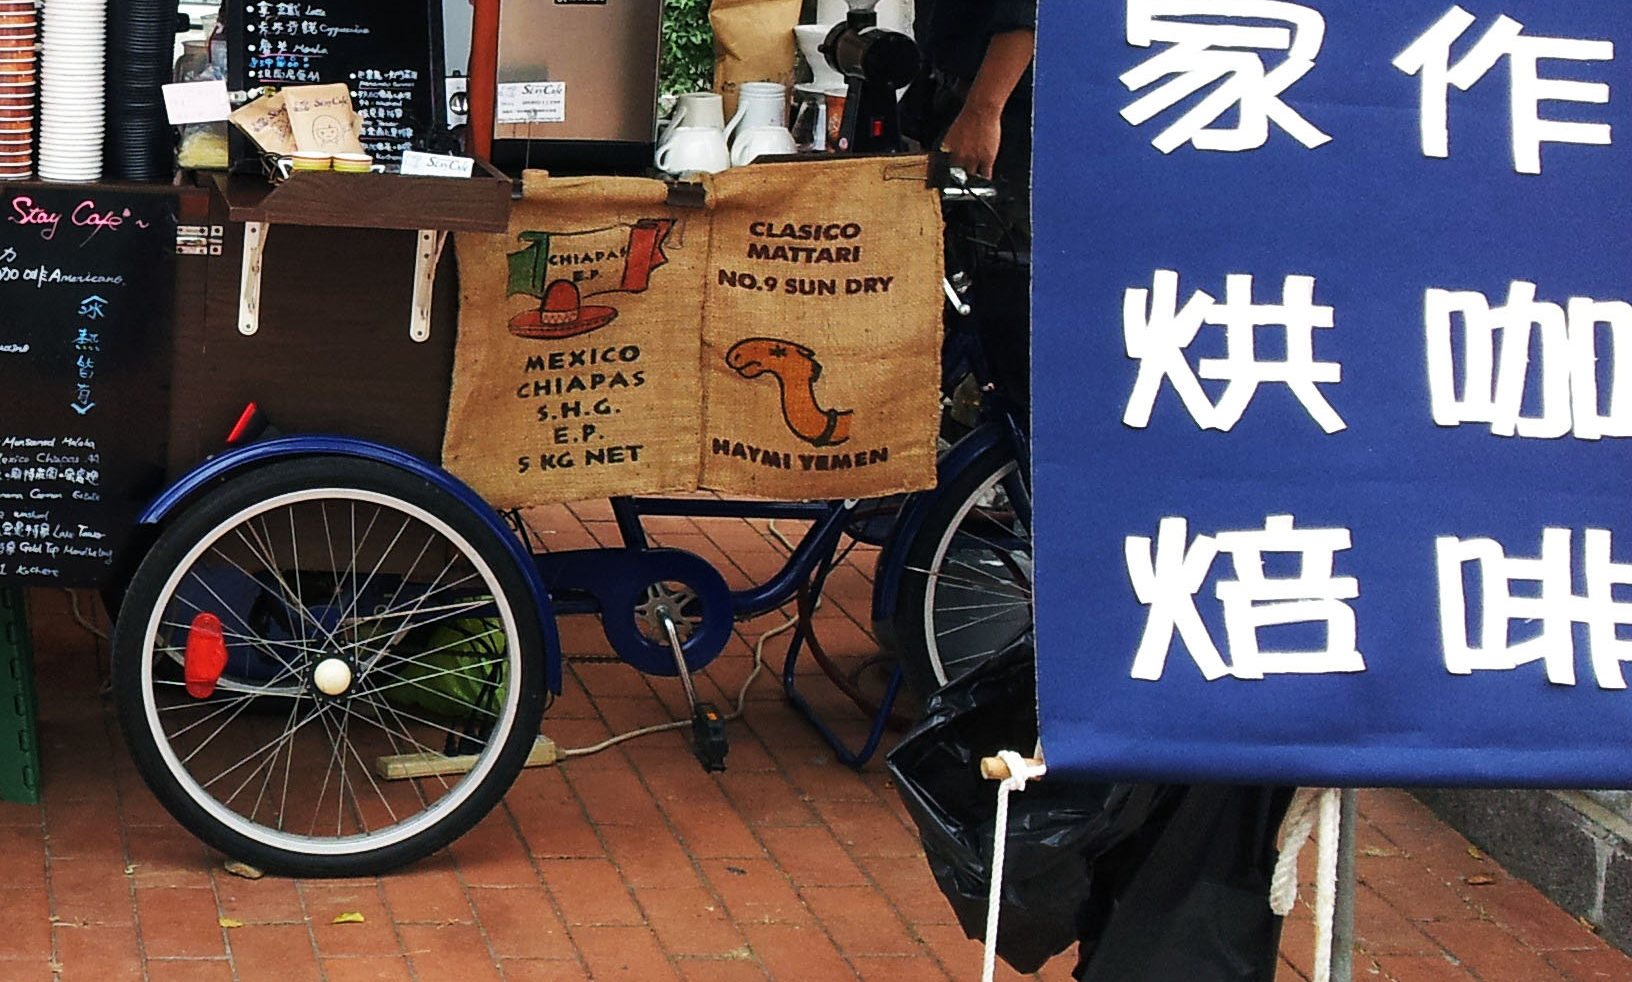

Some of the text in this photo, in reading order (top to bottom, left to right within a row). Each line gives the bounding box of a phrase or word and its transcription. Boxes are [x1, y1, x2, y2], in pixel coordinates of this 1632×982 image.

[8, 196, 63, 241] Stay
[749, 221, 862, 241] CLASICO
[747, 241, 861, 263] MATTARI
[718, 269, 894, 296] NO.9 SUN DRY
[524, 344, 640, 374] MEXICO
[516, 370, 646, 399] CHIAPAS
[537, 396, 622, 422] S.H.G.
[554, 423, 605, 445] E.P.
[518, 444, 643, 474] 5 KG NET
[801, 446, 889, 472] YEMEN
